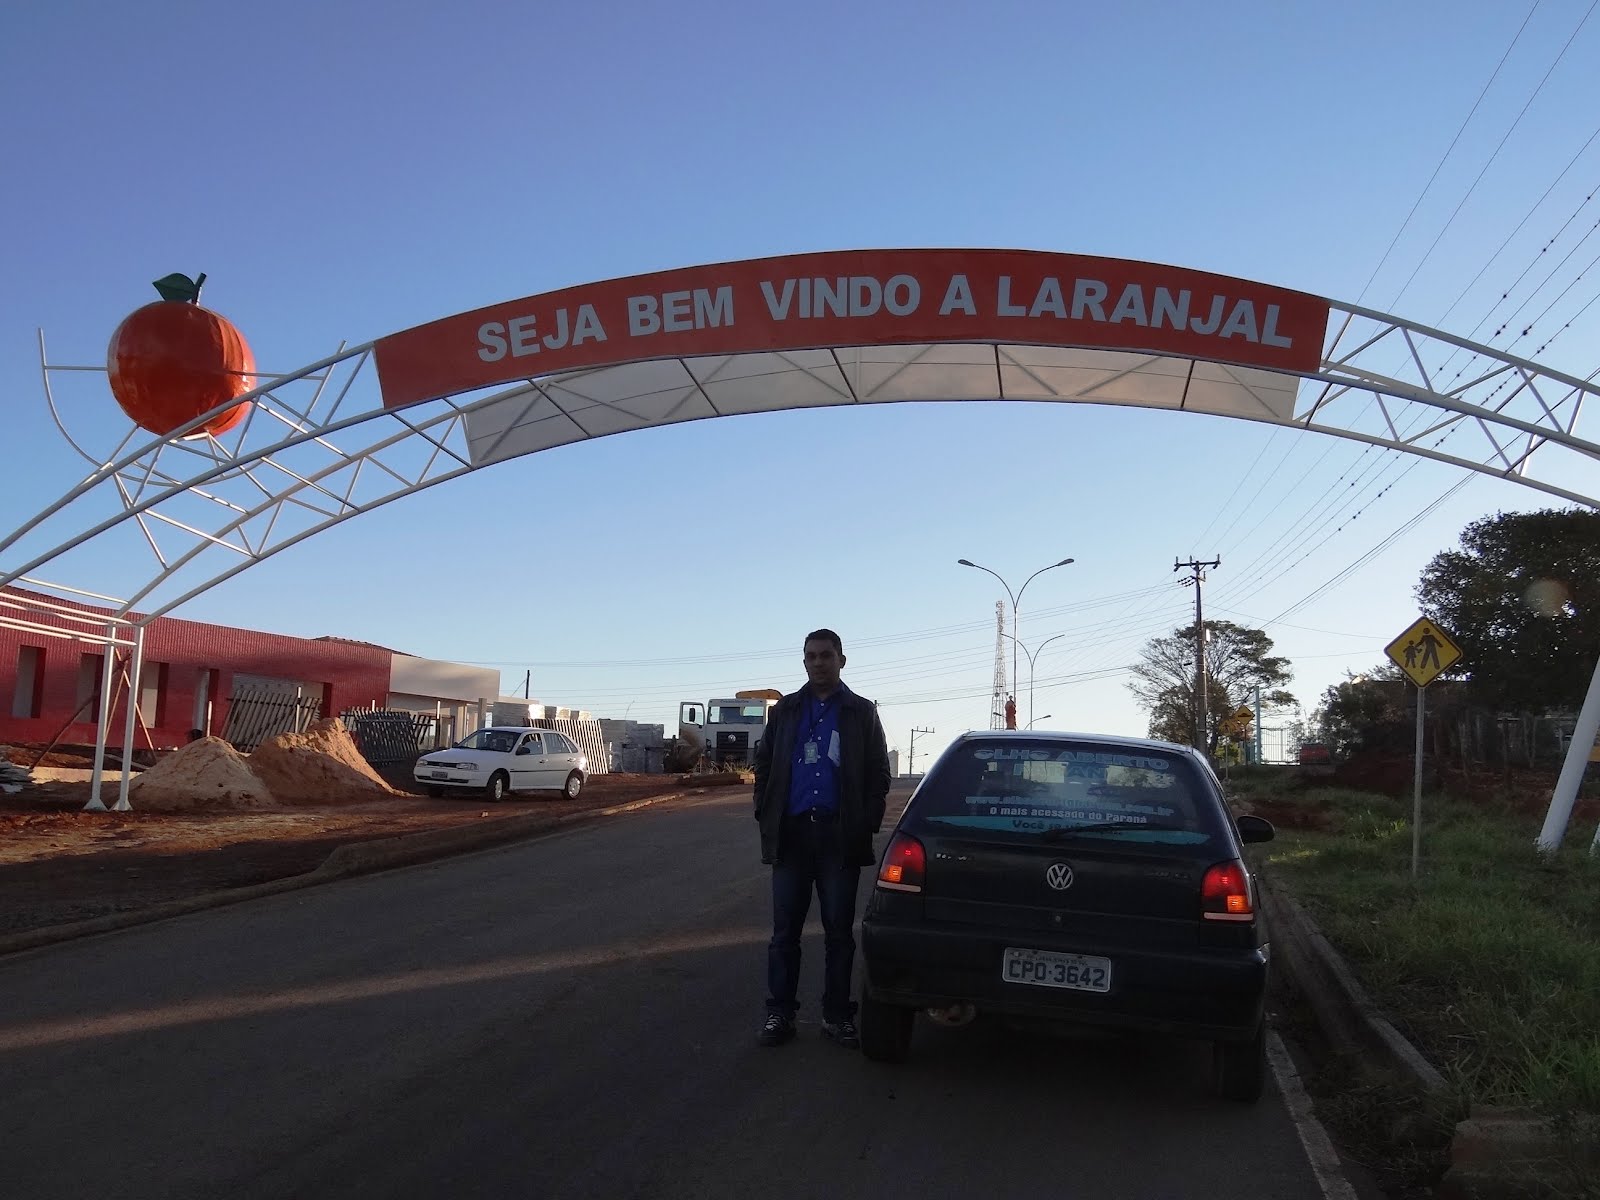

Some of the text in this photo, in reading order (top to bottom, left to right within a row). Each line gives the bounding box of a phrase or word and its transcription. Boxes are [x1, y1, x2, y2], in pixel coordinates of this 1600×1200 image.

[477, 274, 1293, 362] SEJA BEM VINDO A LARANJAL
[1055, 751, 1171, 771] ABERTO
[1000, 807, 1028, 816] mais
[1030, 808, 1085, 819] acessado
[1088, 810, 1102, 820] do
[1105, 812, 1148, 824] Paraná
[1012, 819, 1044, 830] Você
